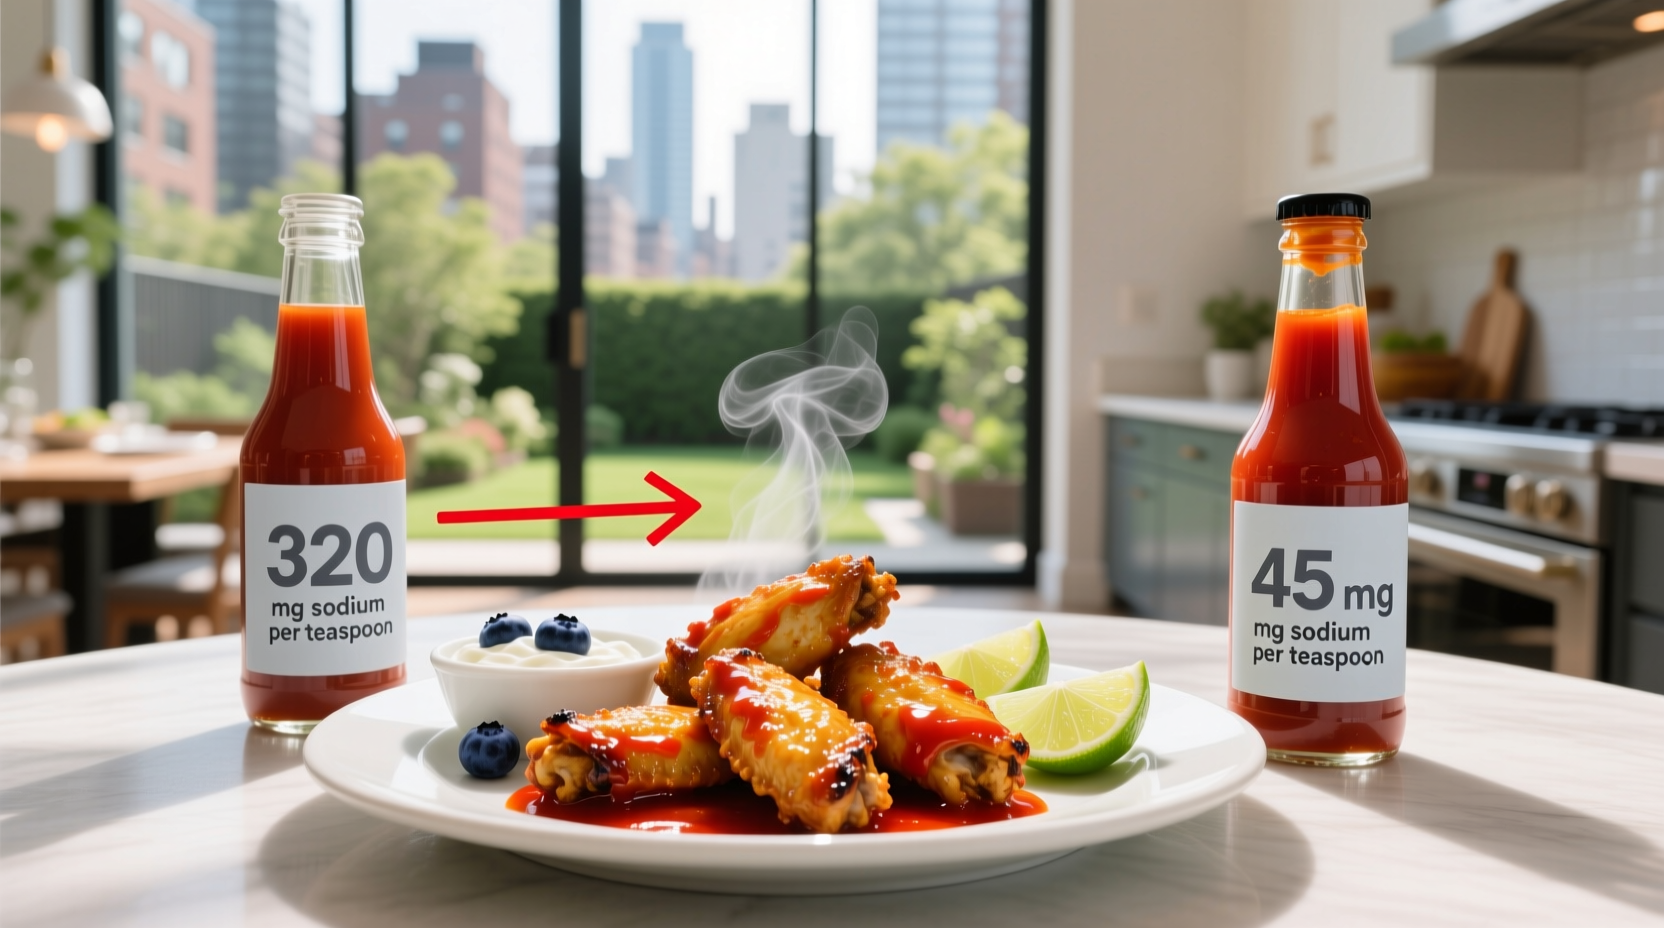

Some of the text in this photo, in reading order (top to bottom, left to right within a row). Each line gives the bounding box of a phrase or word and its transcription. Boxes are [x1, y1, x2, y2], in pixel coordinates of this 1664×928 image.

[267, 521, 393, 588] 320
[1251, 547, 1394, 618] 45 mg
[272, 595, 385, 622] mg sodium
[269, 620, 393, 645] per teaspoon
[1254, 621, 1371, 645] mg sodium
[1253, 645, 1384, 672] per teaspoon
